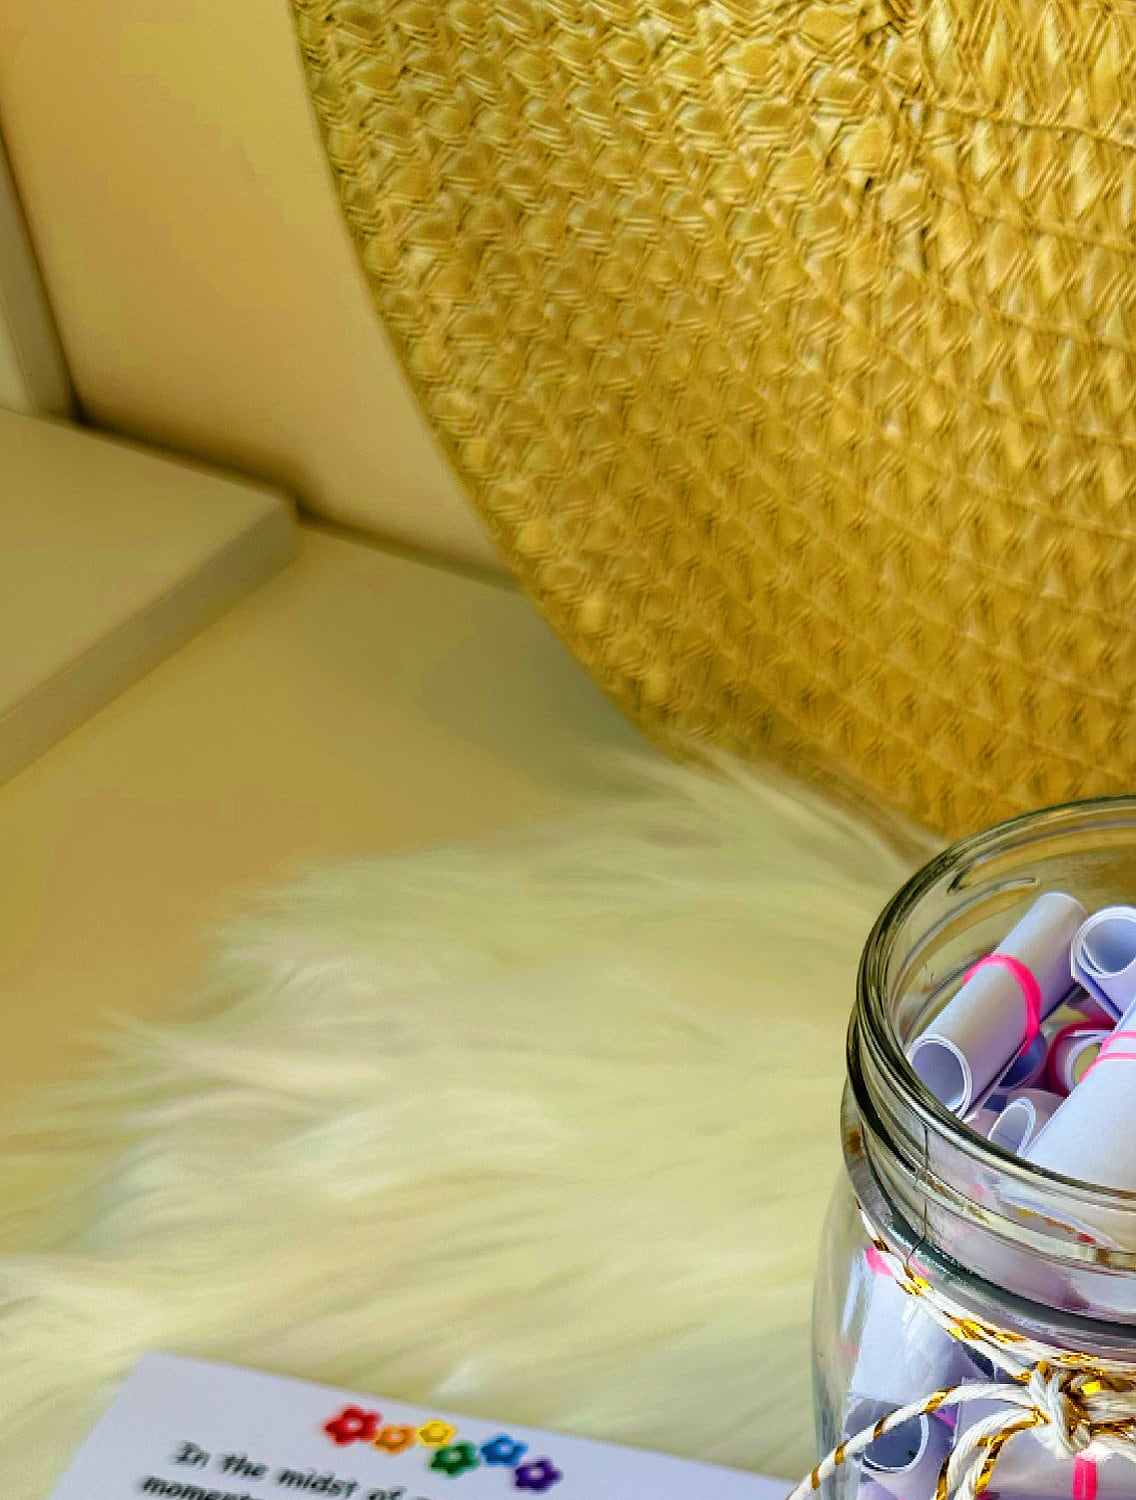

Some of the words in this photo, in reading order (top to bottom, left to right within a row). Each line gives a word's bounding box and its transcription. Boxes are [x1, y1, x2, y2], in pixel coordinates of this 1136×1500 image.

[174, 1441, 210, 1466] In
[222, 1452, 269, 1478] the
[278, 1467, 358, 1499] midst
